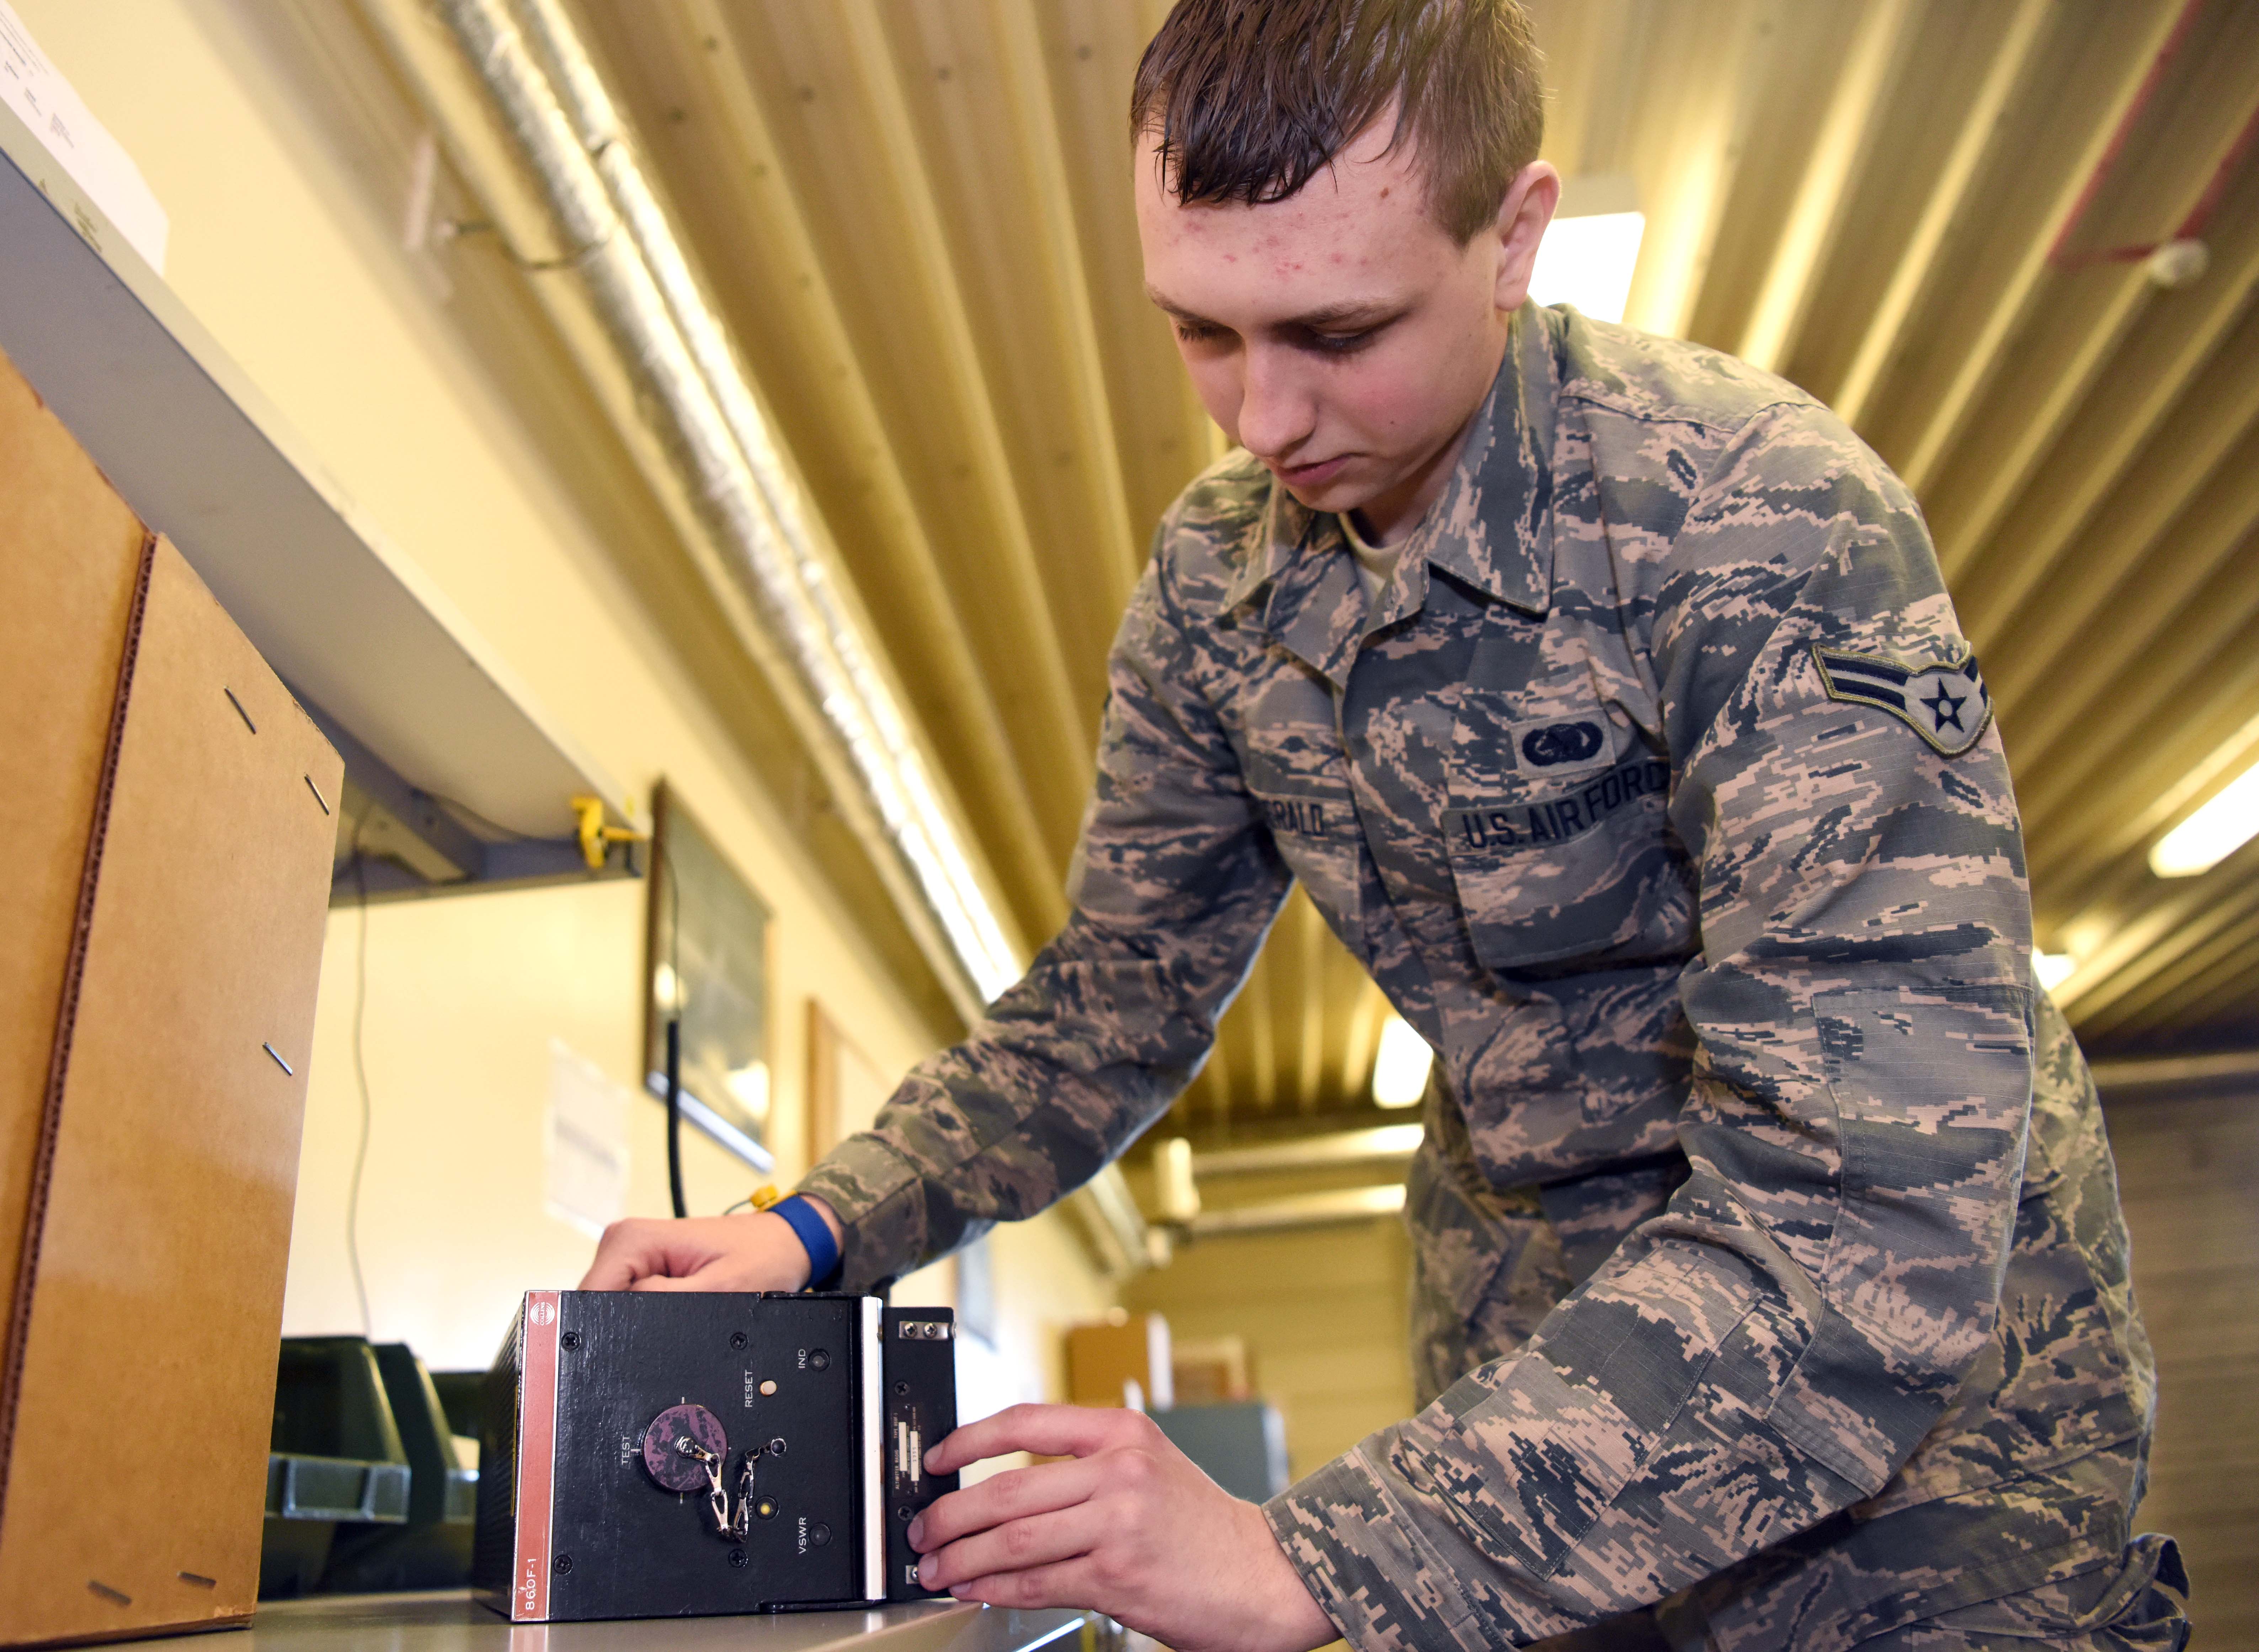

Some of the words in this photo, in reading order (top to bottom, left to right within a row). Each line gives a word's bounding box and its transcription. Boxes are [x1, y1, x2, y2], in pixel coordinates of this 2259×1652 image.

[1463, 812, 1524, 849] U.S.
[1528, 799, 1585, 843] AIR
[622, 1434, 630, 1465] TEST
[526, 1558, 537, 1610] 860F-1
